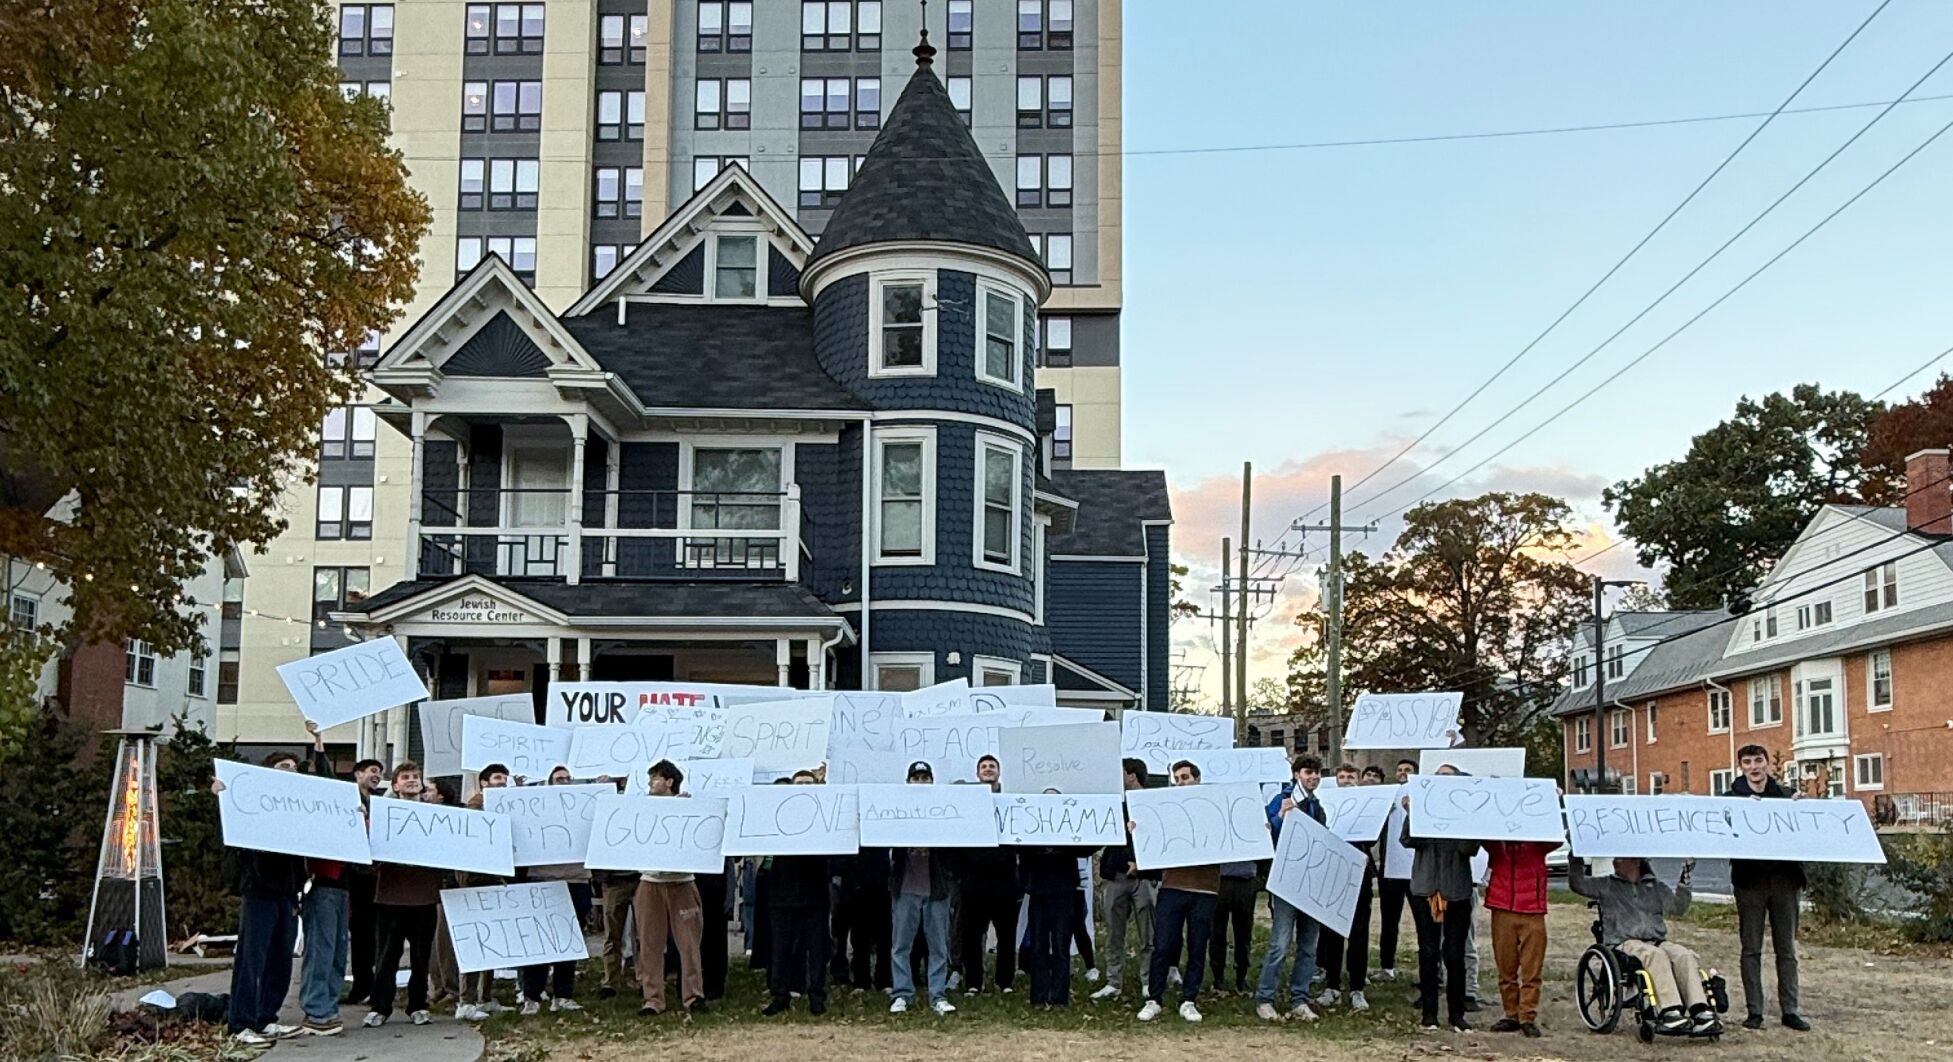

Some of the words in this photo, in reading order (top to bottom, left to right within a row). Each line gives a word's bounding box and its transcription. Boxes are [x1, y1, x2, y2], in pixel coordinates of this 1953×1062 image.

[431, 610, 482, 621] Resource
[487, 610, 525, 622] Center
[459, 598, 496, 610] Jewish
[299, 649, 406, 702] PRIDE
[560, 691, 627, 724] YOUR
[479, 731, 555, 753] SPIRIT
[574, 730, 686, 769] LOVE
[729, 714, 826, 759] SPIRIT
[1021, 746, 1085, 780] Resolve
[385, 806, 497, 845] FAMILY
[603, 806, 725, 851] GUSTO
[738, 792, 858, 838] LOVE
[865, 802, 960, 819] Ambition
[1742, 810, 1856, 836] UNITY
[1278, 820, 1363, 922] PRIDE
[463, 888, 520, 912] LETS
[529, 886, 558, 911] BE
[452, 912, 585, 965] FRIENDS
